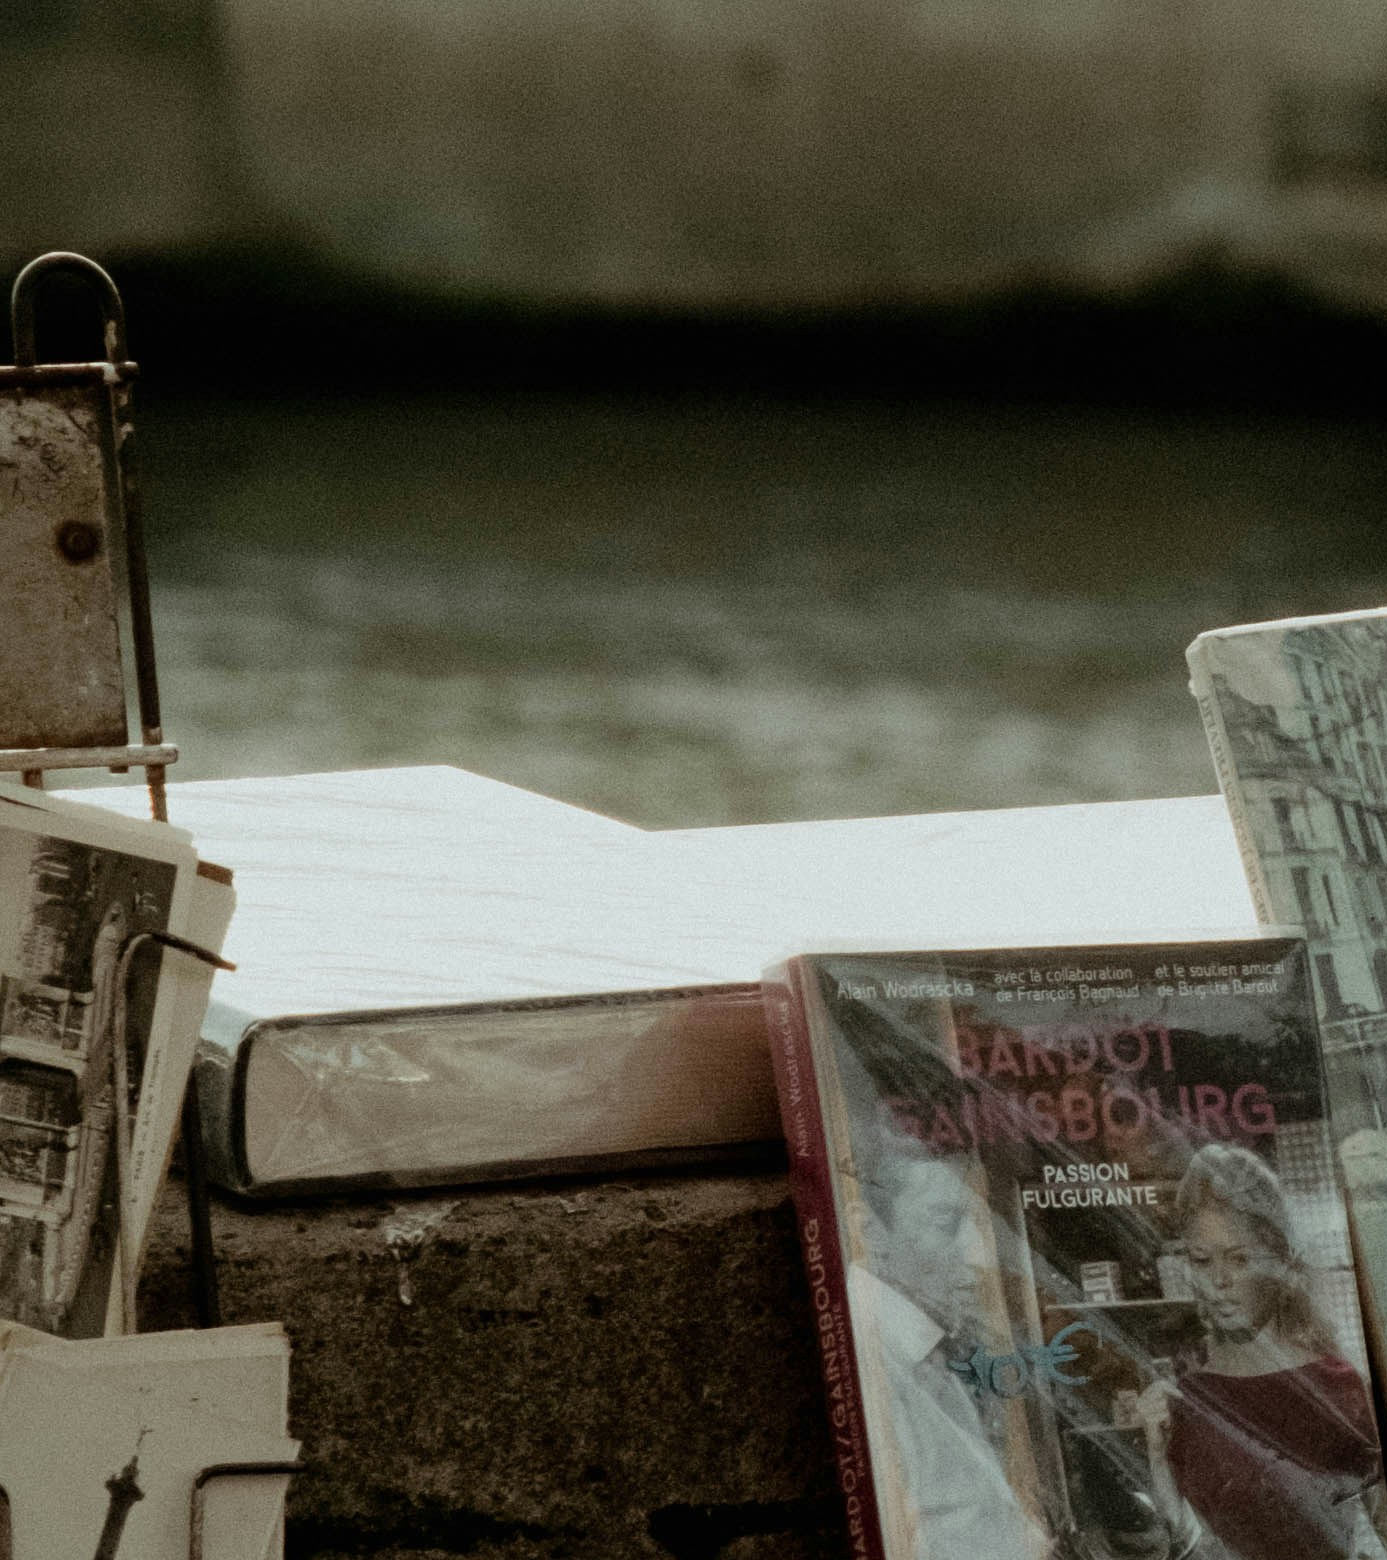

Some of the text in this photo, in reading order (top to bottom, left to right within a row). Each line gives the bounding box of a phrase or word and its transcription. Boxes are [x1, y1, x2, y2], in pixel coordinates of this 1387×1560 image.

[994, 969, 1026, 984] avec
[1047, 965, 1133, 982] collaboration
[1155, 961, 1286, 977] et le soutien amical
[837, 983, 876, 1001] Alain
[1017, 984, 1076, 1005] François
[1080, 983, 1140, 1003] Bagnaud
[1179, 982, 1228, 1001] Brigitte
[952, 1022, 1174, 1082] BARDOT
[880, 1080, 1275, 1152] GAINSBOURG
[1044, 1164, 1128, 1183] PASSION
[1023, 1187, 1157, 1210] FULGURANTE
[804, 1218, 846, 1430] GAINSBOURG
